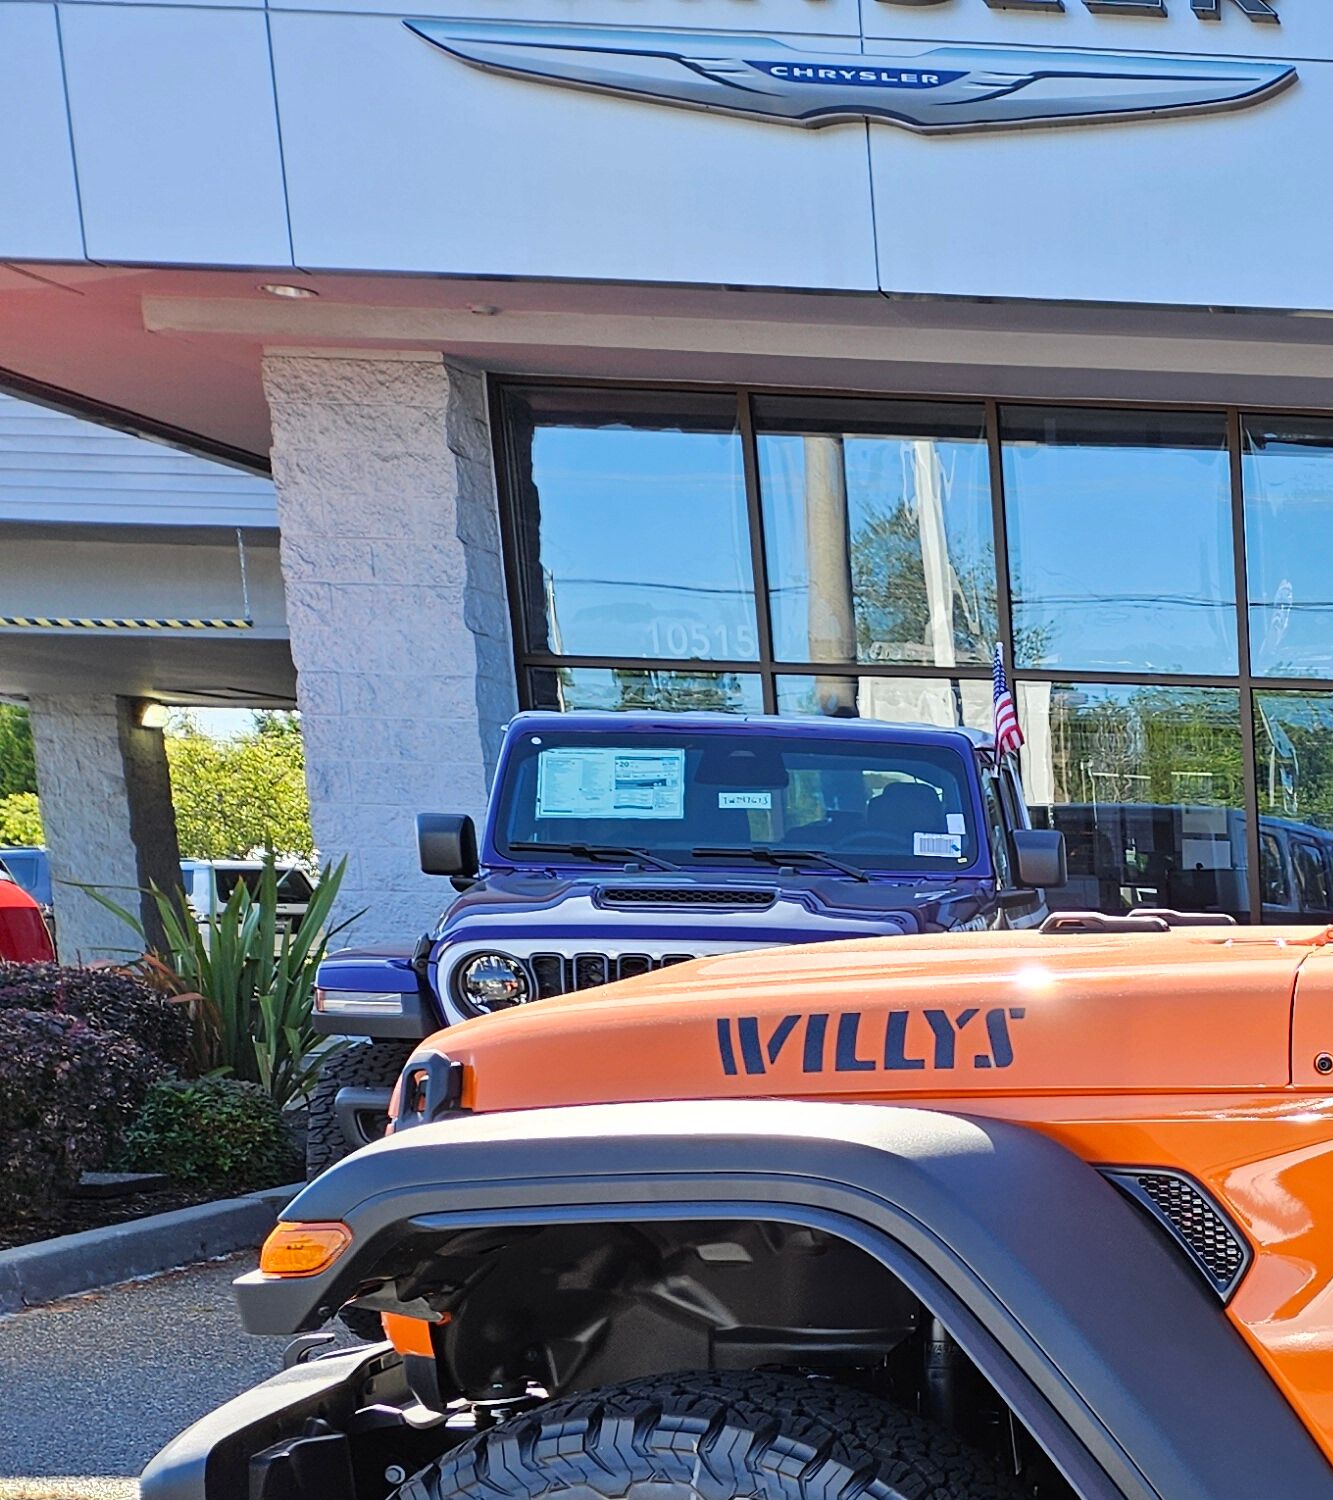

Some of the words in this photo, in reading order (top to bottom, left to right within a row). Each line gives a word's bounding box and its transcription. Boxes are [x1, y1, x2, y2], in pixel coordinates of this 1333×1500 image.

[769, 65, 940, 85] CHRYSLER
[646, 620, 758, 659] 10515
[716, 1006, 1027, 1076] WILLYS
